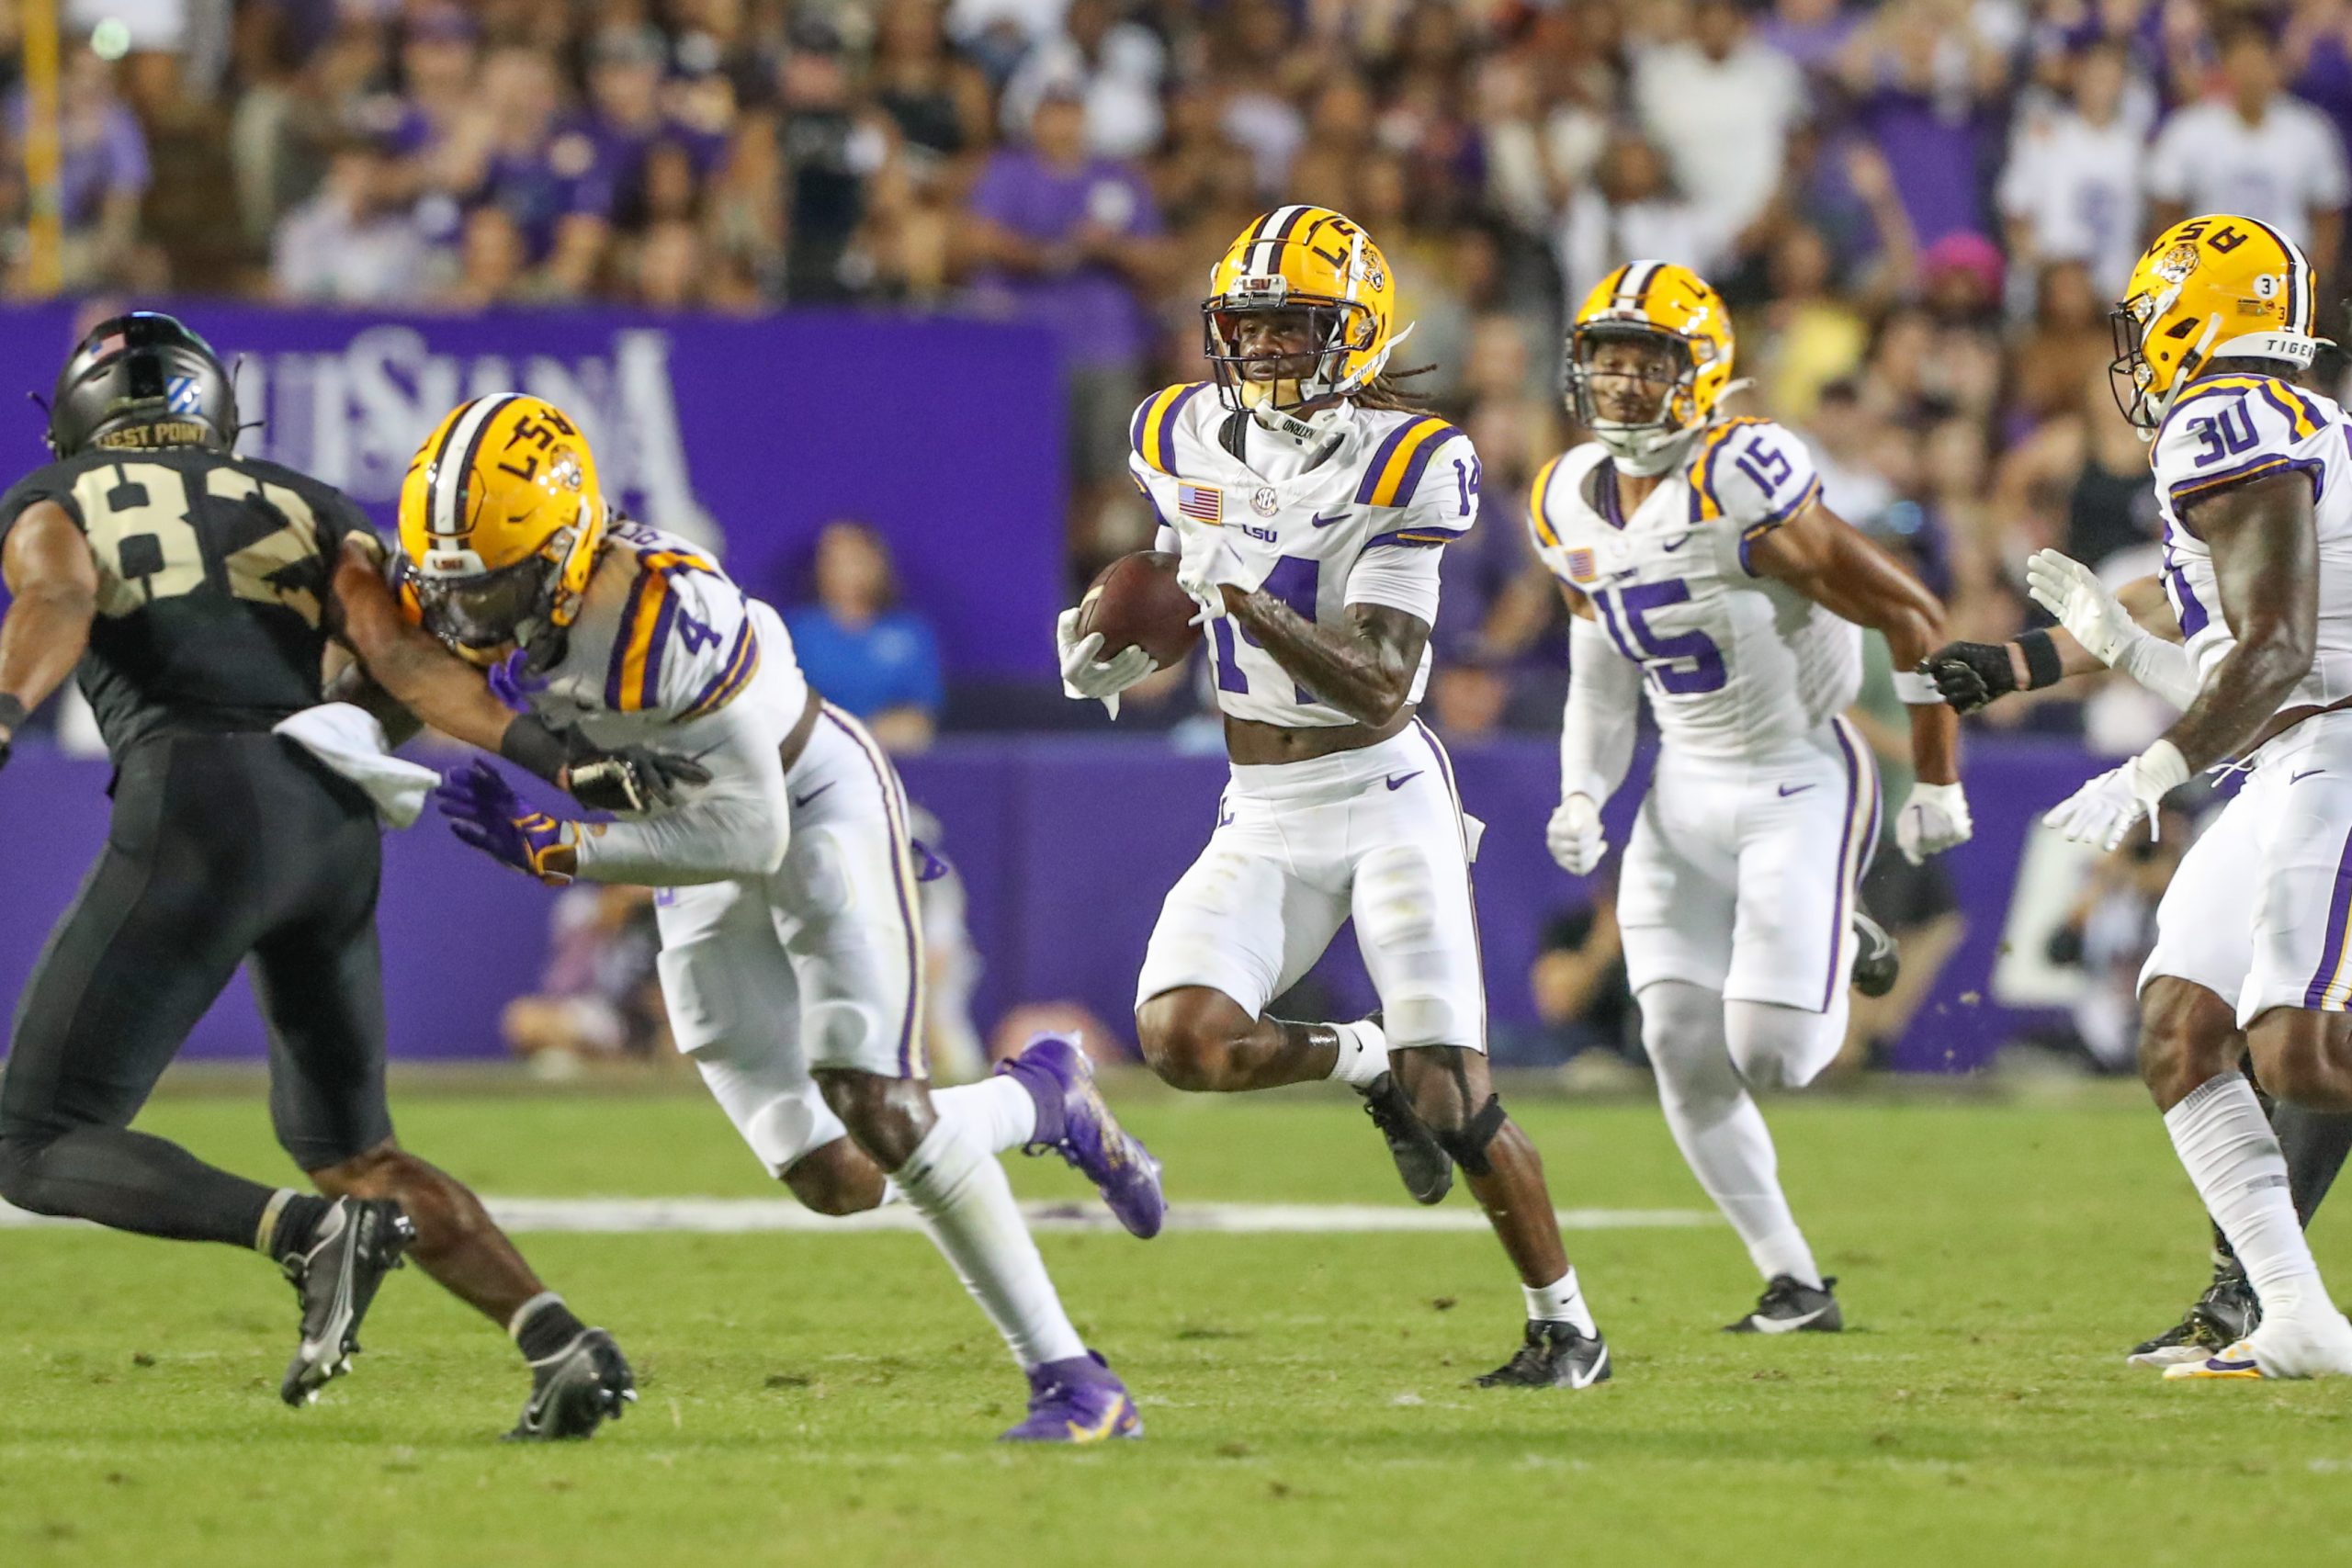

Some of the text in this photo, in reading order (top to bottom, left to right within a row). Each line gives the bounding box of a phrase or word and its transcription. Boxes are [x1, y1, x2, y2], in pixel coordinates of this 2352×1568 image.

[1242, 278, 1272, 291] LSU
[2261, 278, 2270, 295] 3
[154, 423, 208, 444] POINT
[1282, 419, 1317, 440] NXTRND
[2186, 397, 2259, 468] 30
[1453, 455, 1483, 516] 14
[1735, 436, 1792, 500] 15
[71, 462, 321, 630] 82
[1242, 524, 1277, 544] LSU
[678, 607, 723, 656] 4
[1592, 578, 1728, 694] 15
